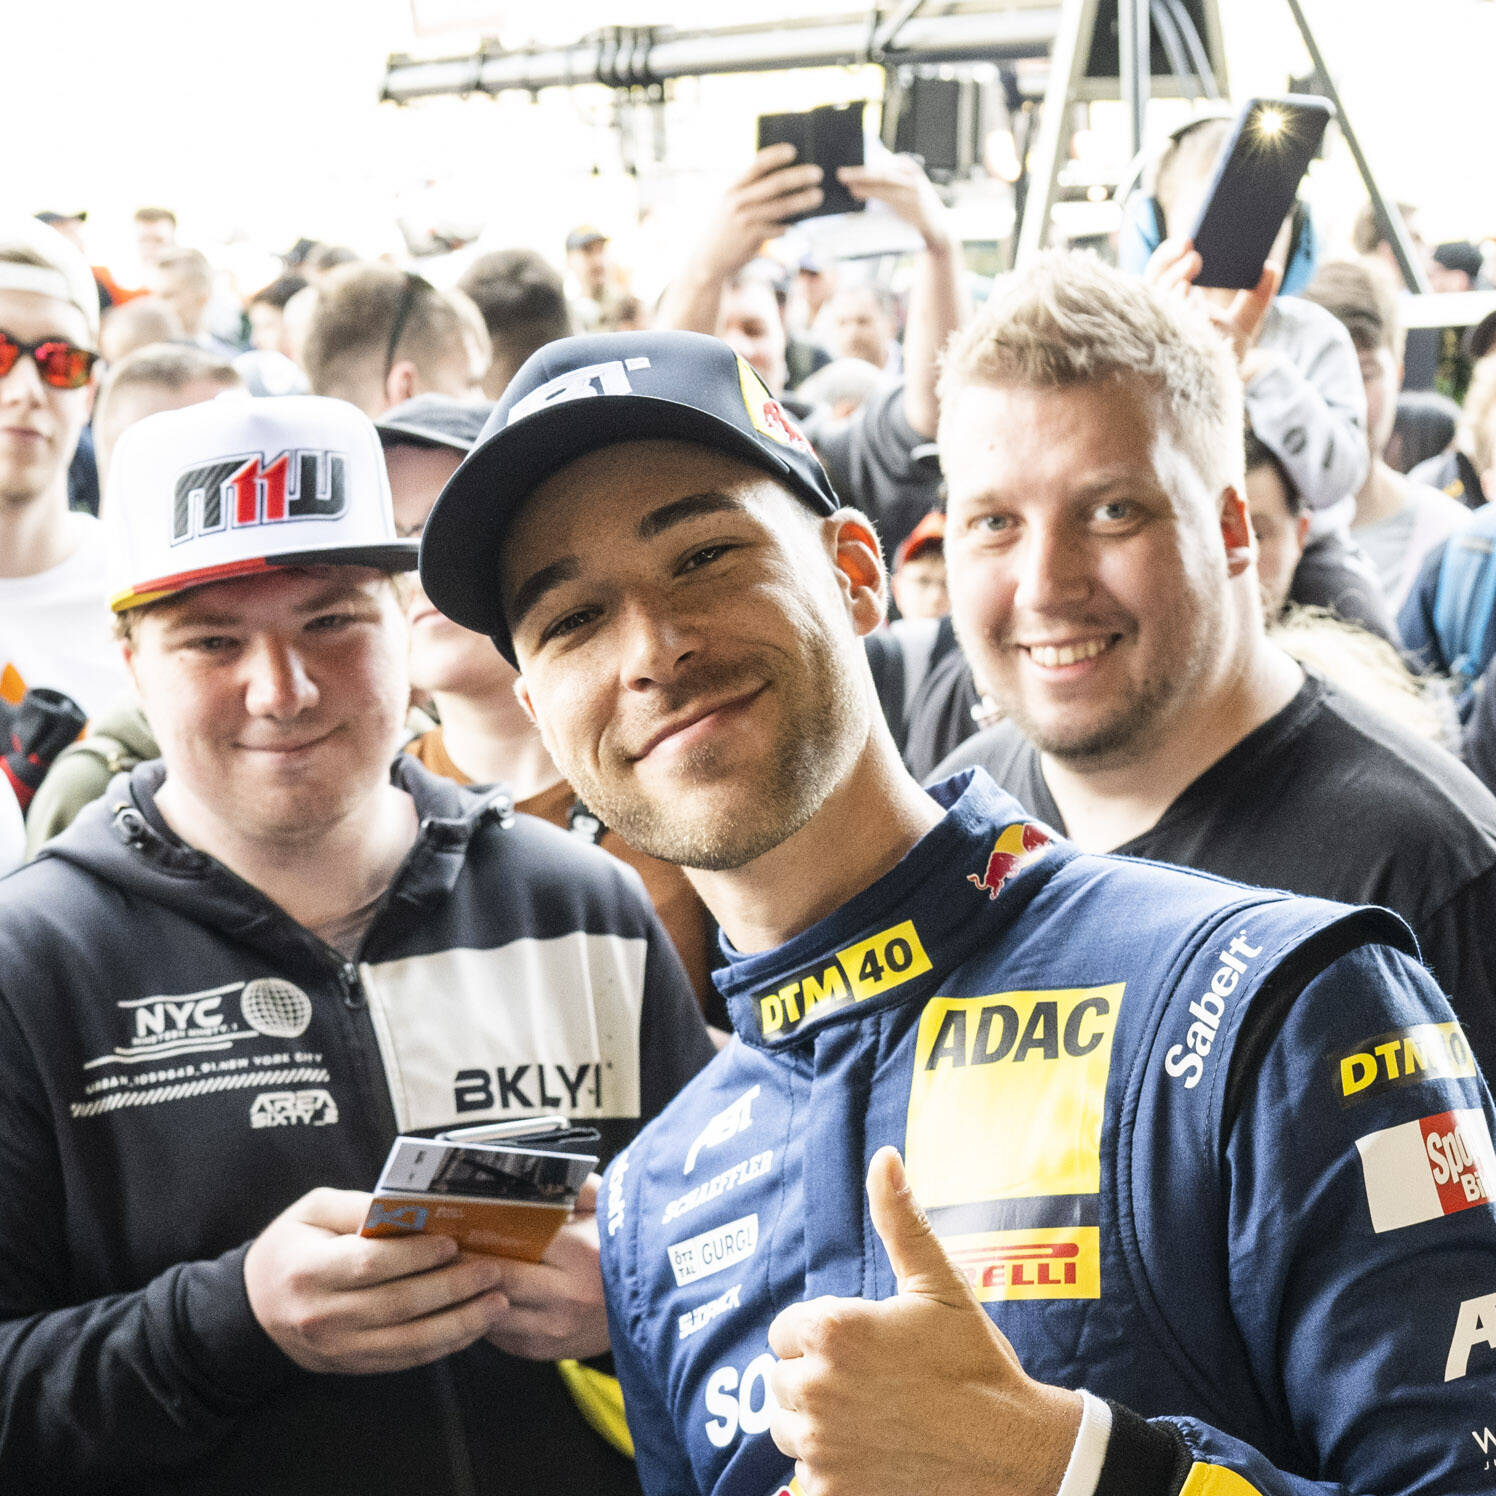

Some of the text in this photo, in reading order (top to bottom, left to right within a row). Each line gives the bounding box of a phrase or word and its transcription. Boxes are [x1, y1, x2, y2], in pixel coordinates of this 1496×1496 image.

[135, 996, 224, 1038] NYC
[760, 936, 914, 1037] DTM 40
[1164, 929, 1262, 1090] Sabelt
[924, 996, 1110, 1071] ADAC
[1426, 1122, 1474, 1186] Spo
[678, 1264, 696, 1279] TAL
[701, 1228, 754, 1266] GURGL
